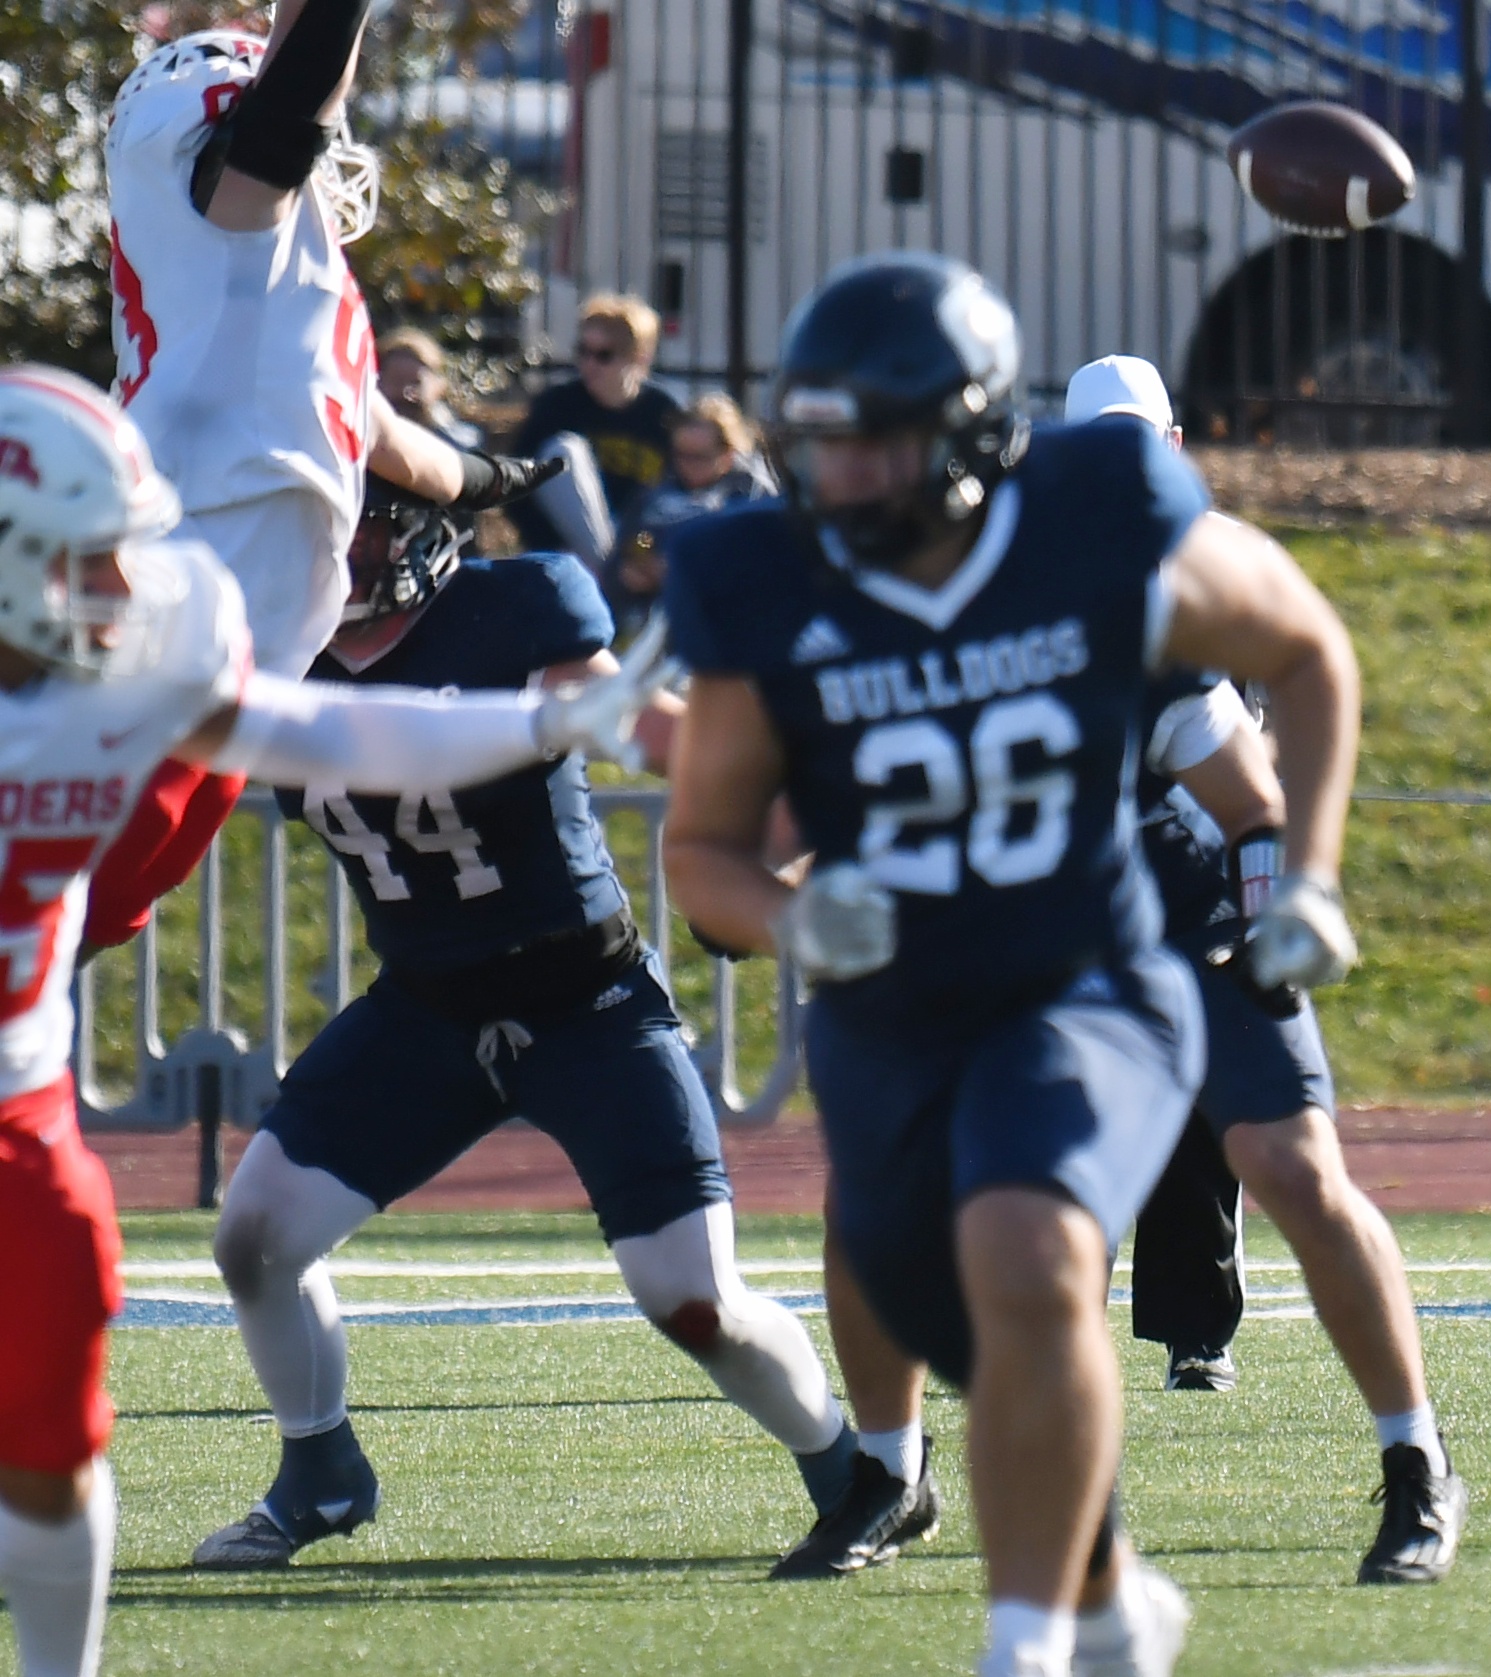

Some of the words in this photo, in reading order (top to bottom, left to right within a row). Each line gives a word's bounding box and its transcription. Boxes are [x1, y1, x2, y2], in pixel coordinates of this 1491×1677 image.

[816, 617, 1090, 724] BULLDOGS
[302, 780, 503, 902] 44
[853, 692, 1083, 896] 26
